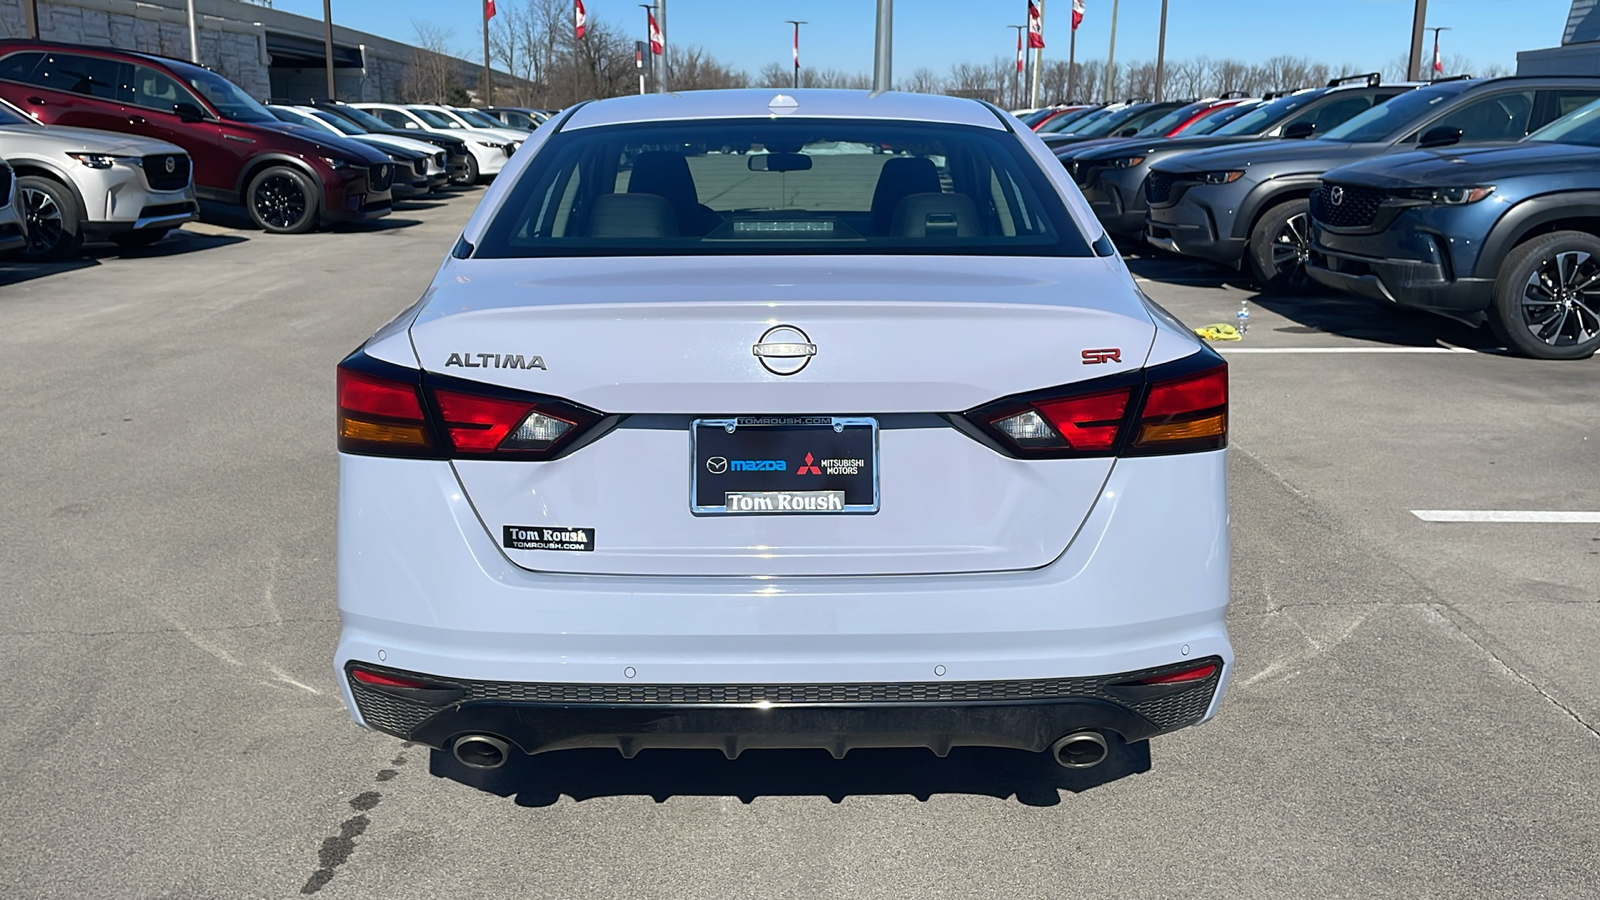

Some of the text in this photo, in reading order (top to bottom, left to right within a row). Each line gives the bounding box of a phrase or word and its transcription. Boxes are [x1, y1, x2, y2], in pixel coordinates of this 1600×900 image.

[754, 344, 816, 355] NISSAN
[444, 353, 547, 370] ALTIMA
[1082, 348, 1122, 364] SR
[821, 459, 864, 467] MITSUBISHI
[827, 466, 858, 475] MOTORS
[728, 493, 842, 510] Tom Roush
[510, 528, 588, 542] Tom Roush
[513, 541, 584, 550] TOMROUSH.COM
